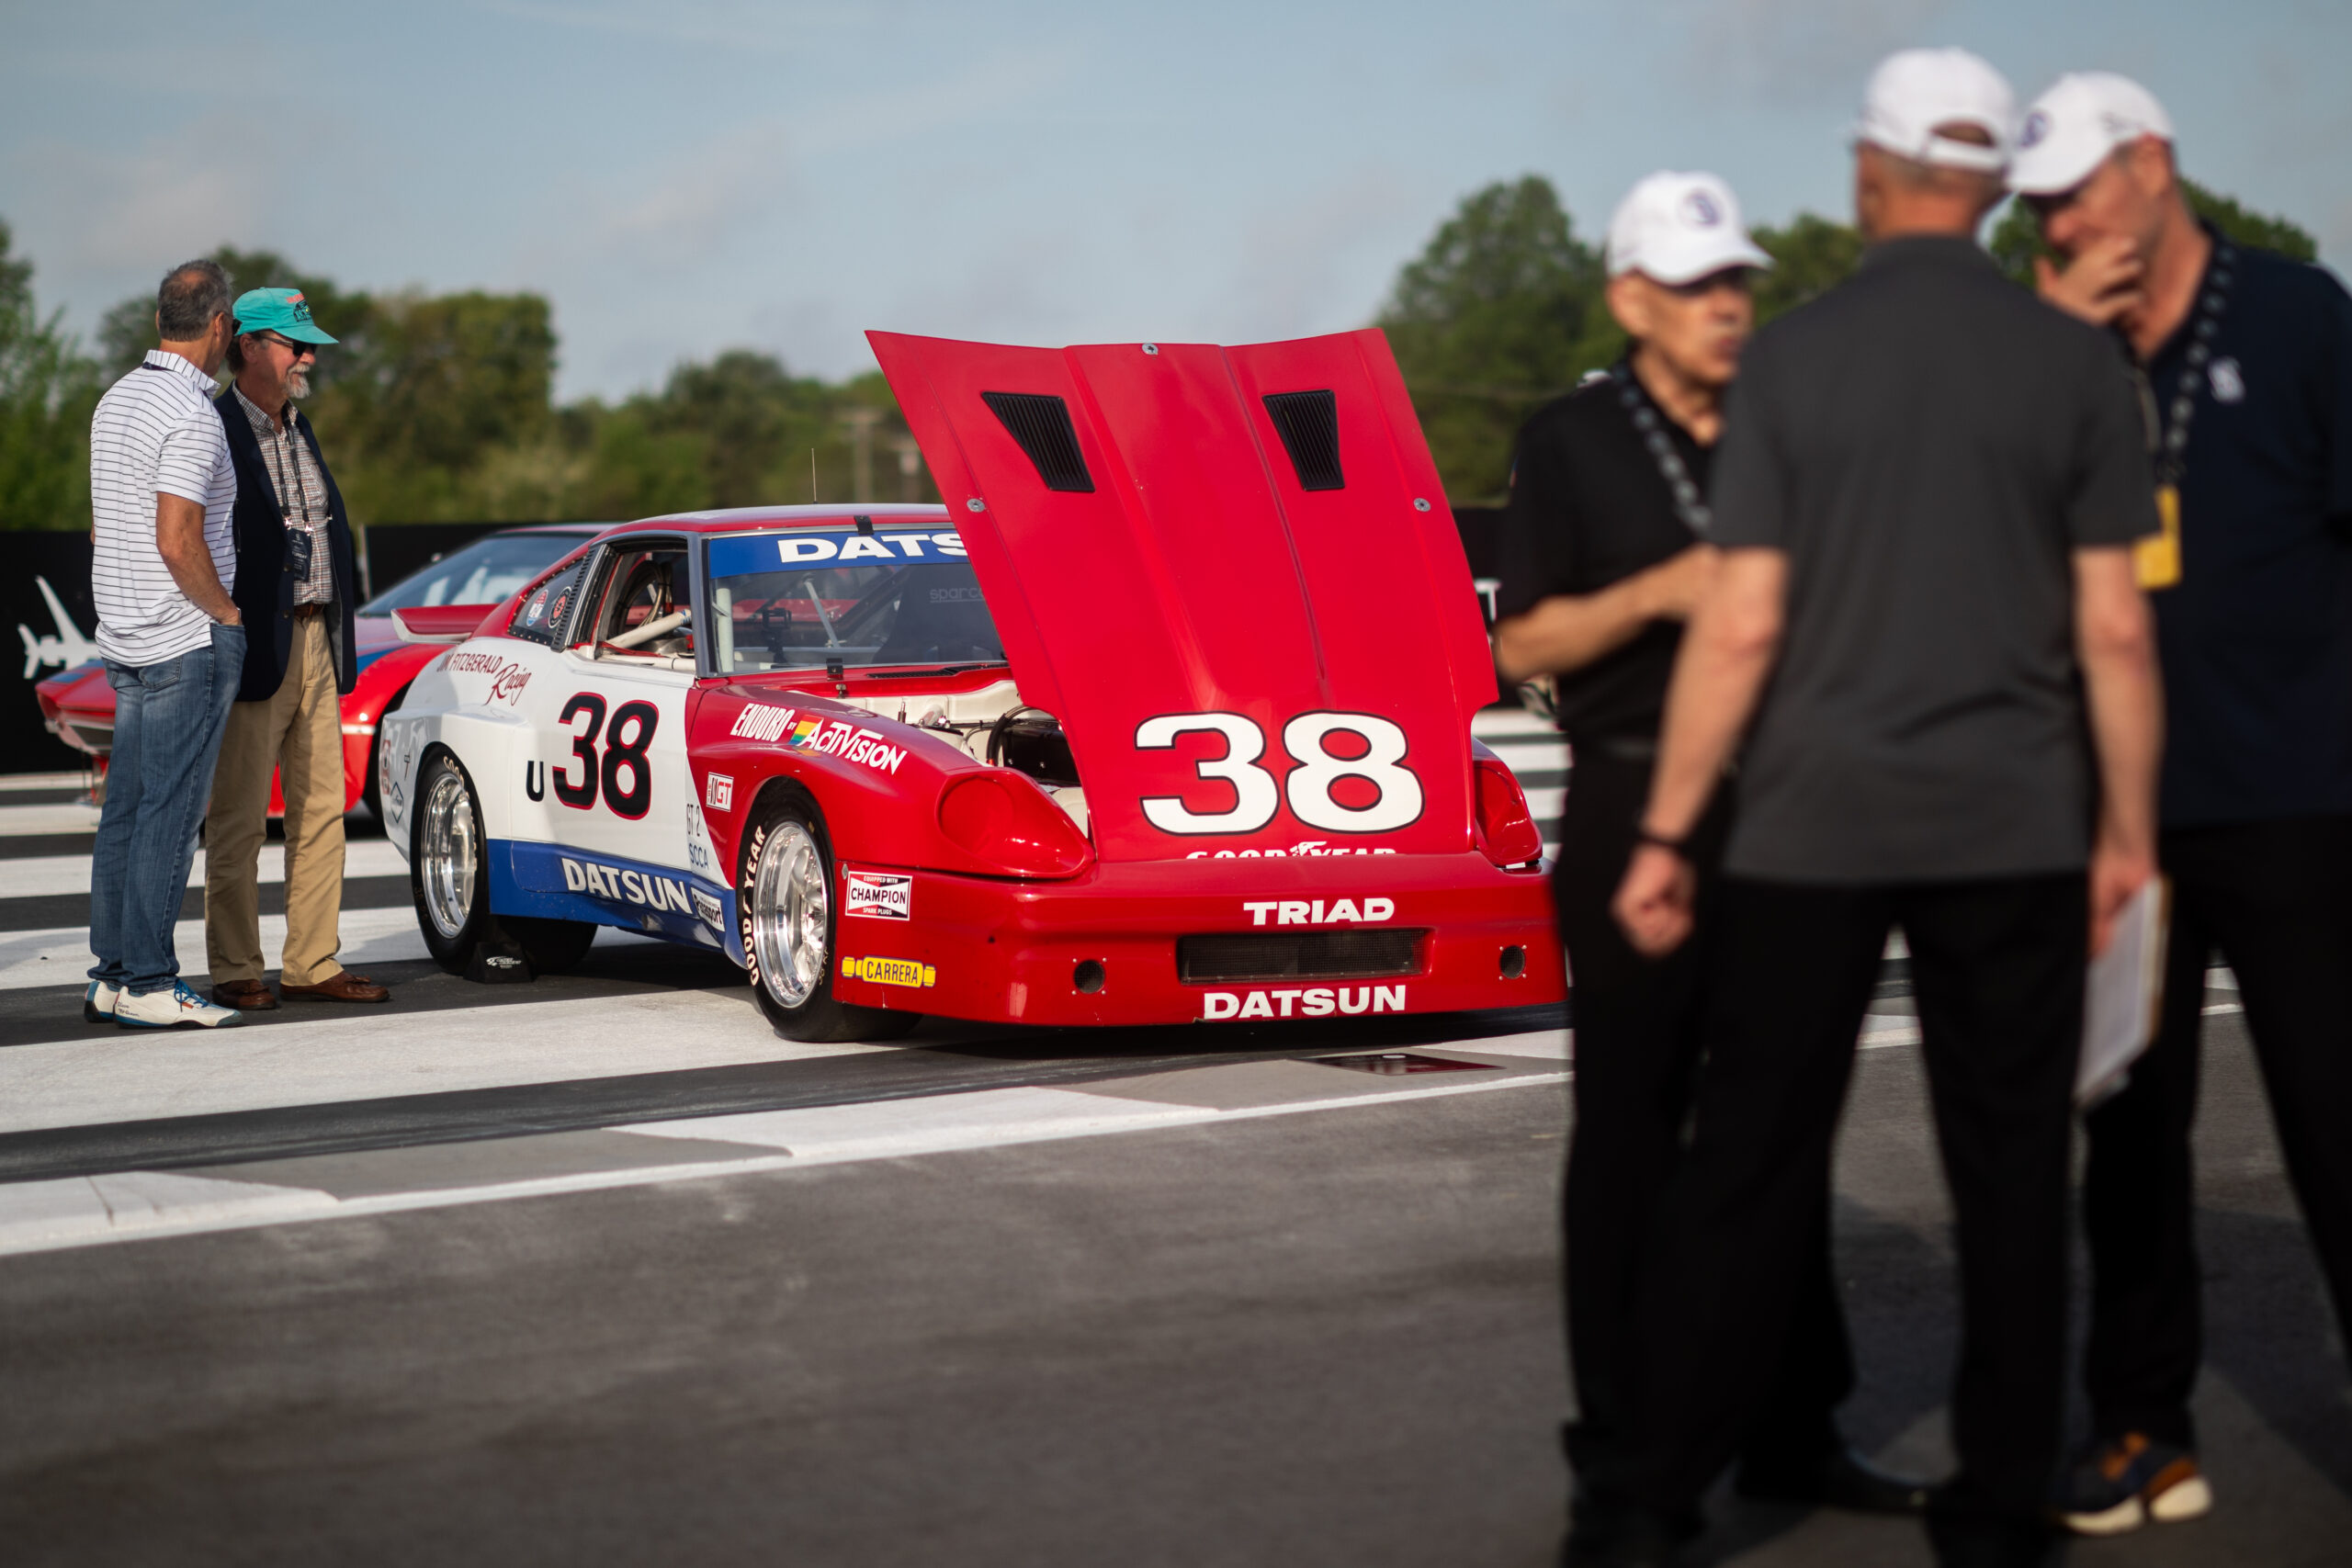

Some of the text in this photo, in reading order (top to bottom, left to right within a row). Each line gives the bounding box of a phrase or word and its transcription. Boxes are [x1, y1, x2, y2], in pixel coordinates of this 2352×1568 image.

[777, 534, 968, 562] DATS
[930, 588, 981, 603] sparc
[450, 652, 503, 673] FITZGERALD
[481, 663, 532, 706] Racing
[729, 703, 796, 742] ENDURO
[787, 722, 797, 730] BY
[526, 692, 660, 820] U 38
[1133, 709, 1426, 837] 38
[688, 843, 709, 870] SCCA
[561, 857, 693, 915] DATSUN
[851, 887, 907, 905] CHAMPION
[877, 908, 893, 916] PLUGS
[1243, 897, 1395, 926] TRIAD
[865, 961, 918, 985] CARRERA
[1204, 985, 1407, 1020] DATSUN
